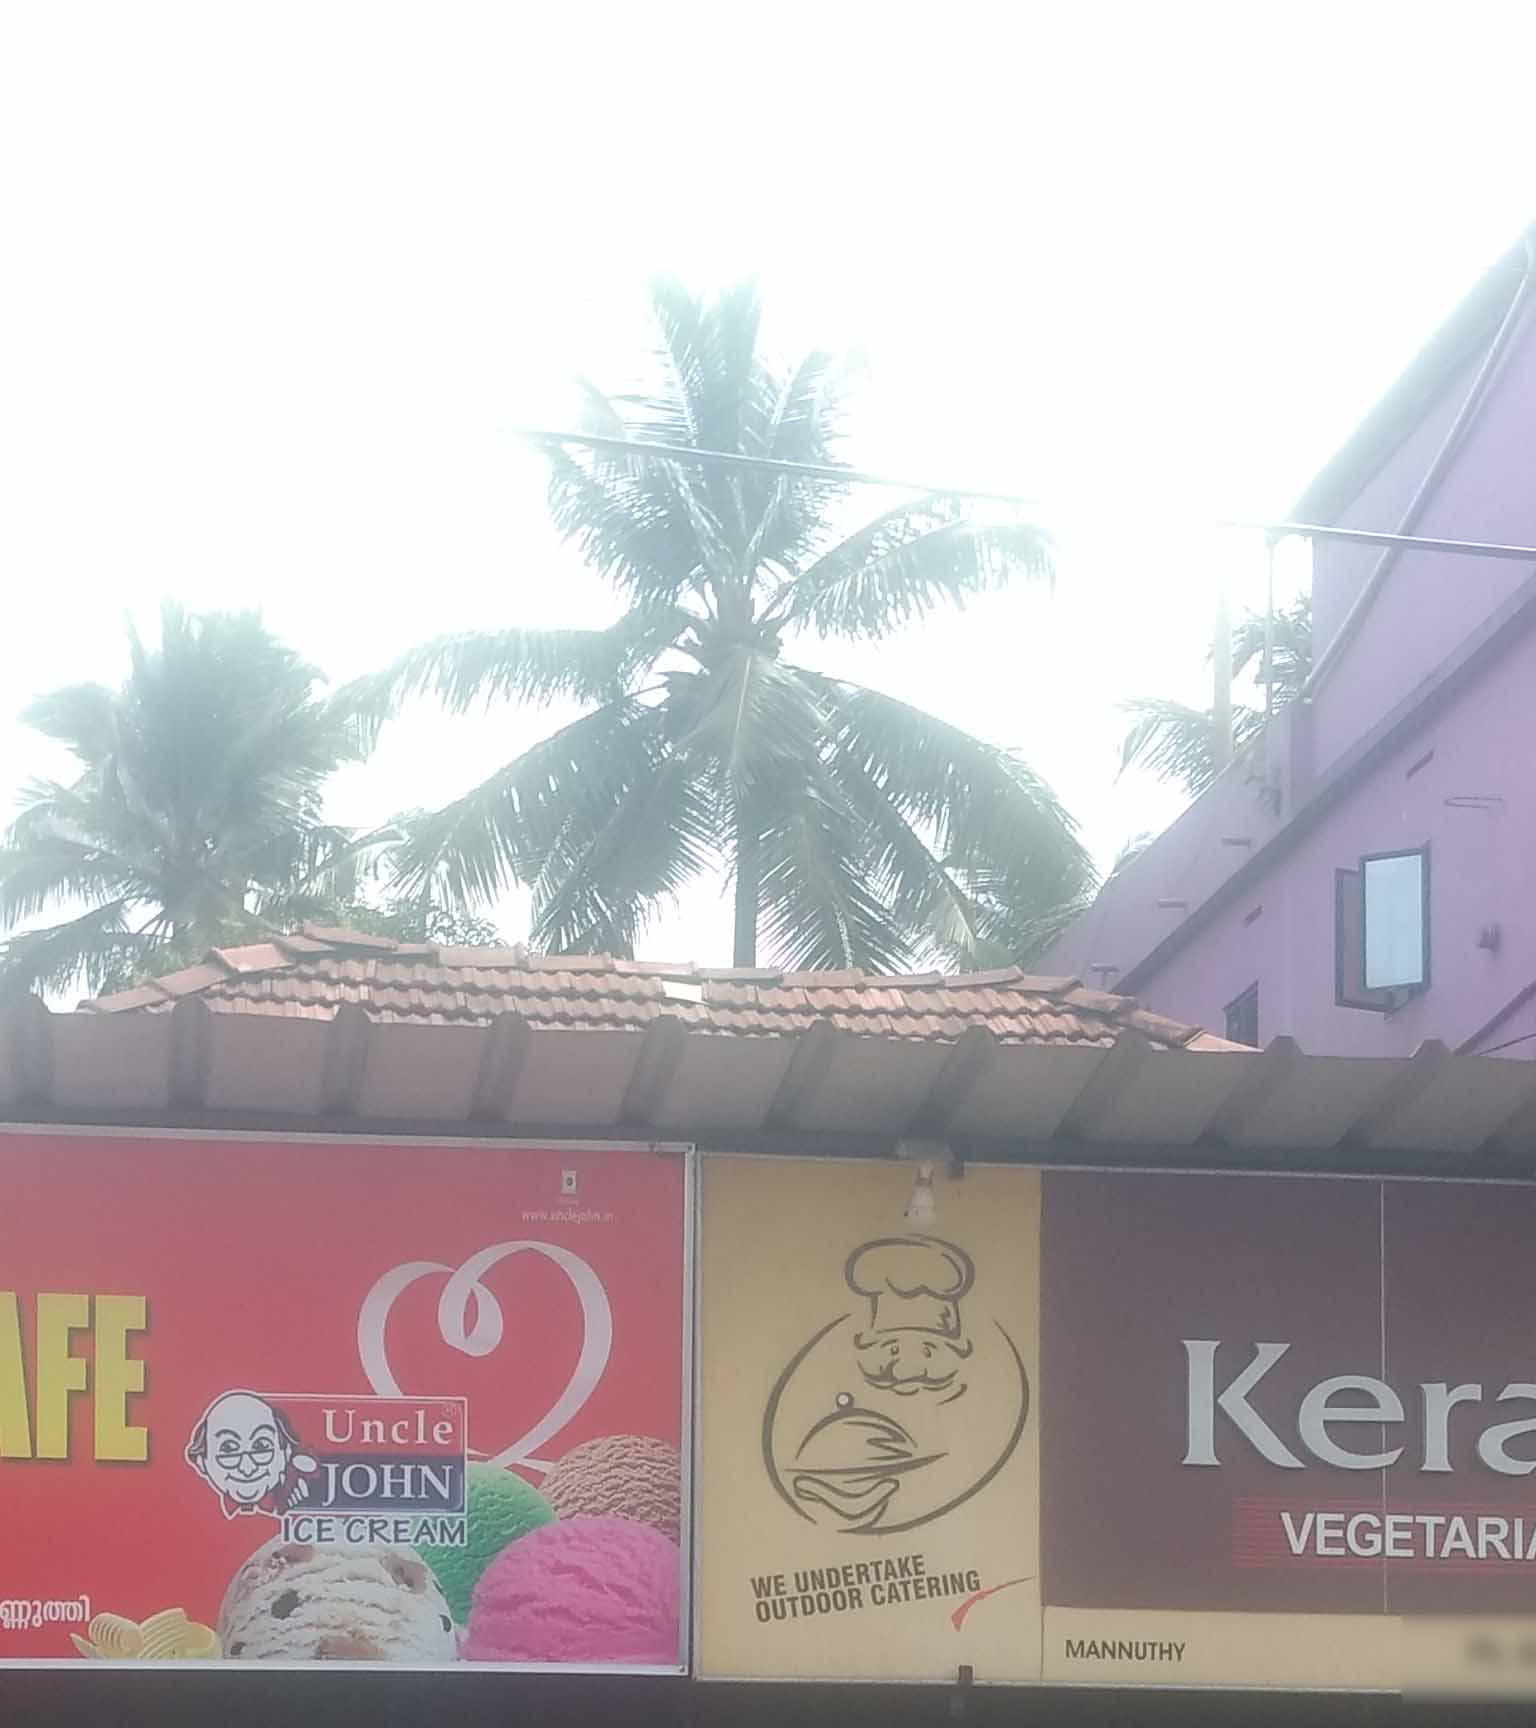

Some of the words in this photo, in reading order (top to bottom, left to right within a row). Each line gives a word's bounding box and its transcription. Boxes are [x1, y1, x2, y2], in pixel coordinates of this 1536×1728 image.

[322, 1408, 454, 1445] Uncle
[321, 1463, 454, 1507] JOHN
[282, 1516, 336, 1543] ICE
[345, 1517, 467, 1545] CREAM
[751, 1573, 786, 1601] WE
[794, 1553, 926, 1594] UNDERTAKE
[755, 1587, 865, 1624] OUTDOOR
[869, 1569, 982, 1608] CATERING
[1065, 1638, 1186, 1662] MANNUTHY
